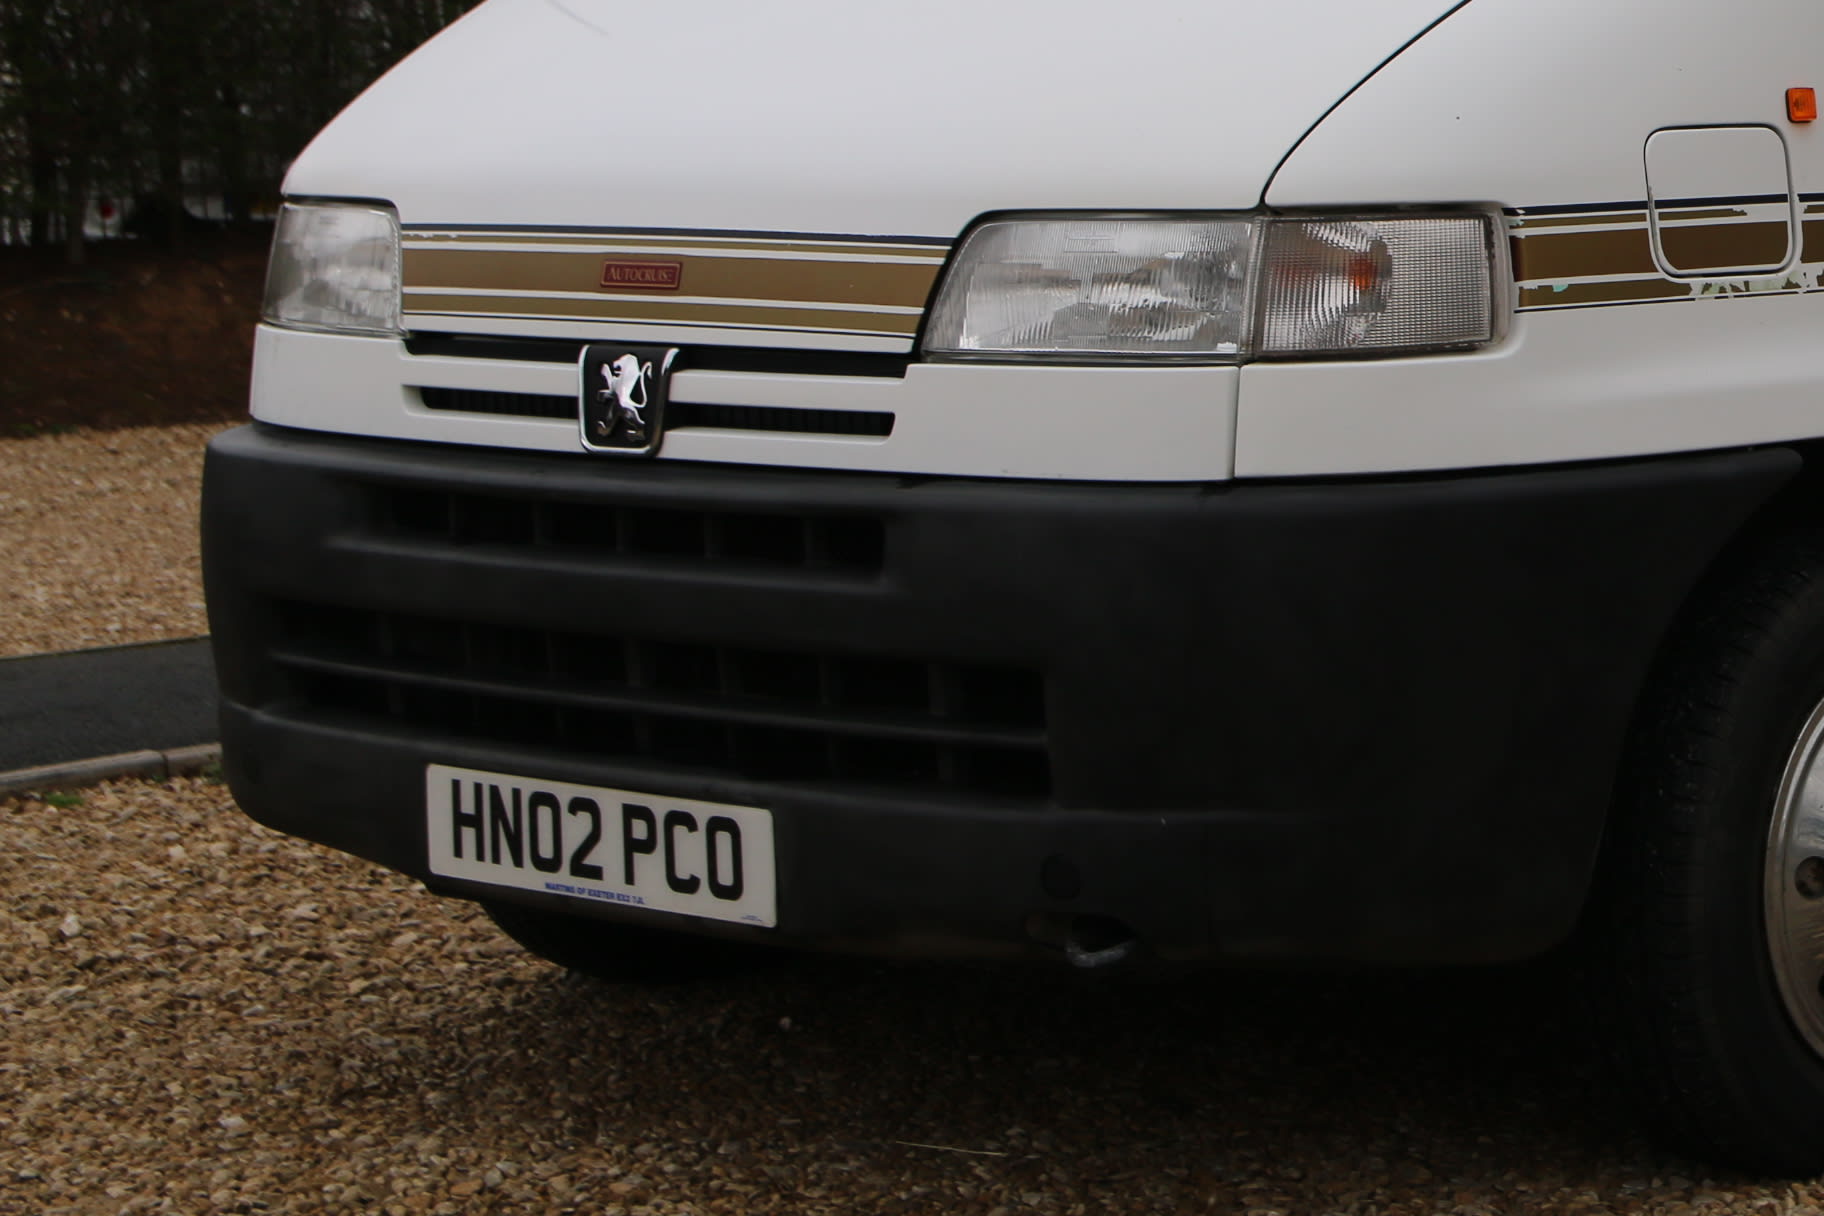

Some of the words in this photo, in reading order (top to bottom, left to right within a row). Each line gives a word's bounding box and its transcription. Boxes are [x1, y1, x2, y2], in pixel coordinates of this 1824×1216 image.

[606, 266, 673, 282] AUTOCRUISE
[451, 779, 604, 881] HN02
[621, 802, 744, 901] PCO
